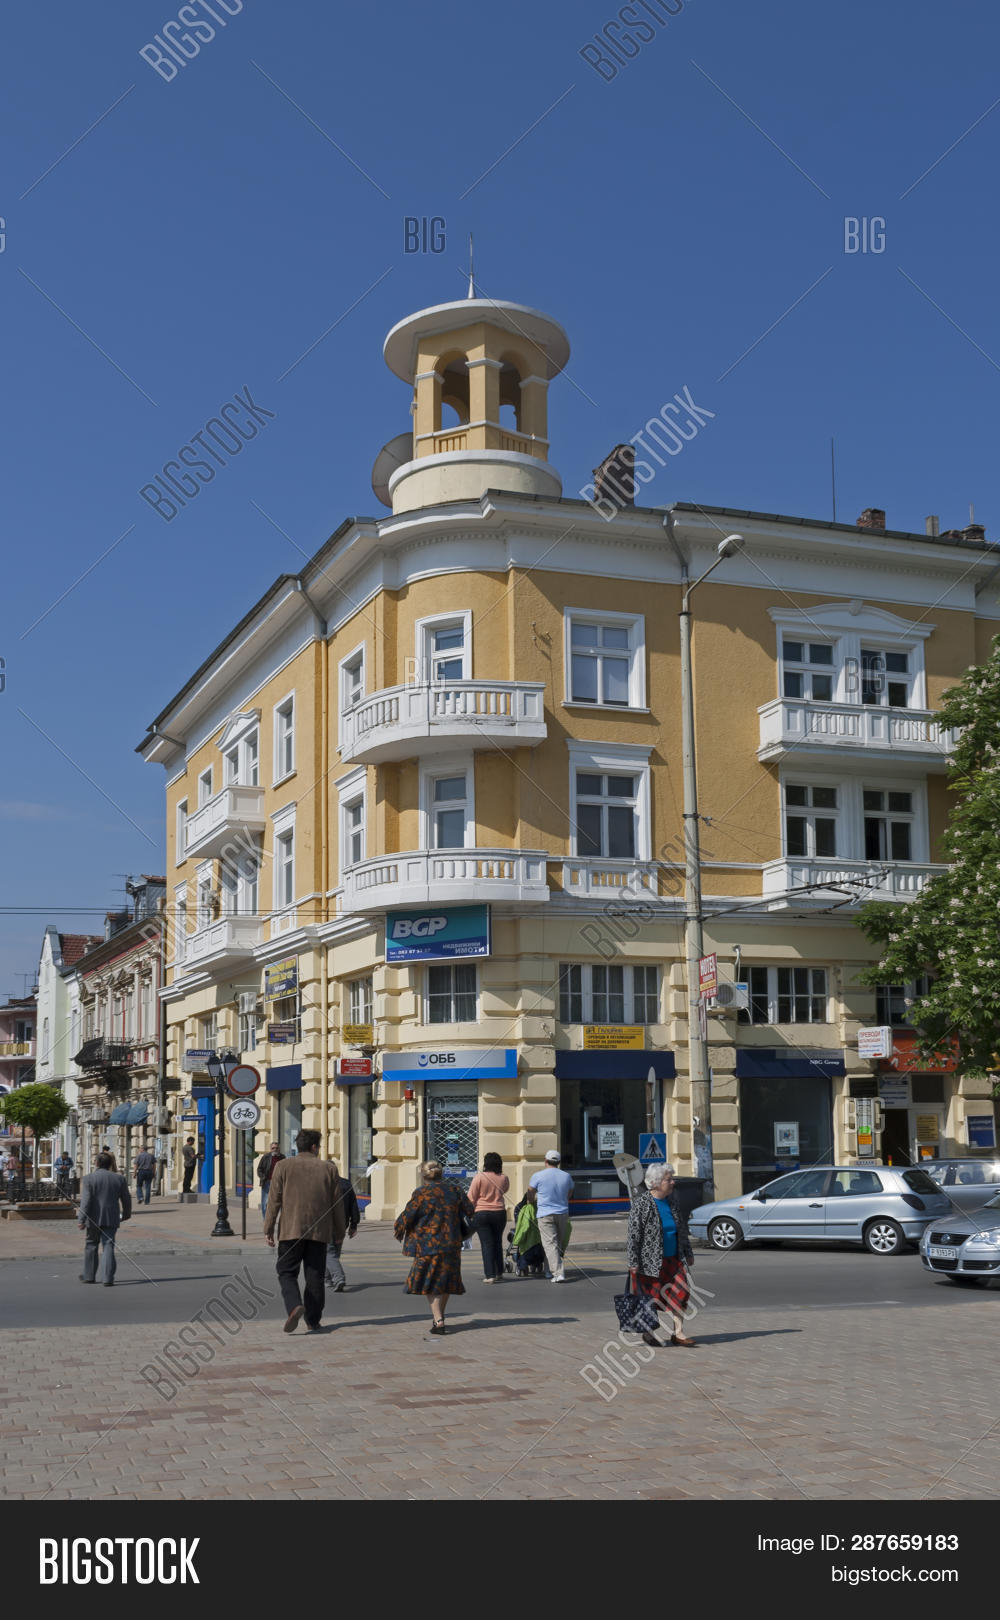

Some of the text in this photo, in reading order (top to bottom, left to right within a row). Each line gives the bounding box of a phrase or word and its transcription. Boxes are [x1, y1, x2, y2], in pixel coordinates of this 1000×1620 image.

[391, 917, 448, 939] BGP
[455, 946, 486, 955] ИМОТИ
[700, 955, 716, 977] HOTEL
[429, 1053, 456, 1064] ОББ
